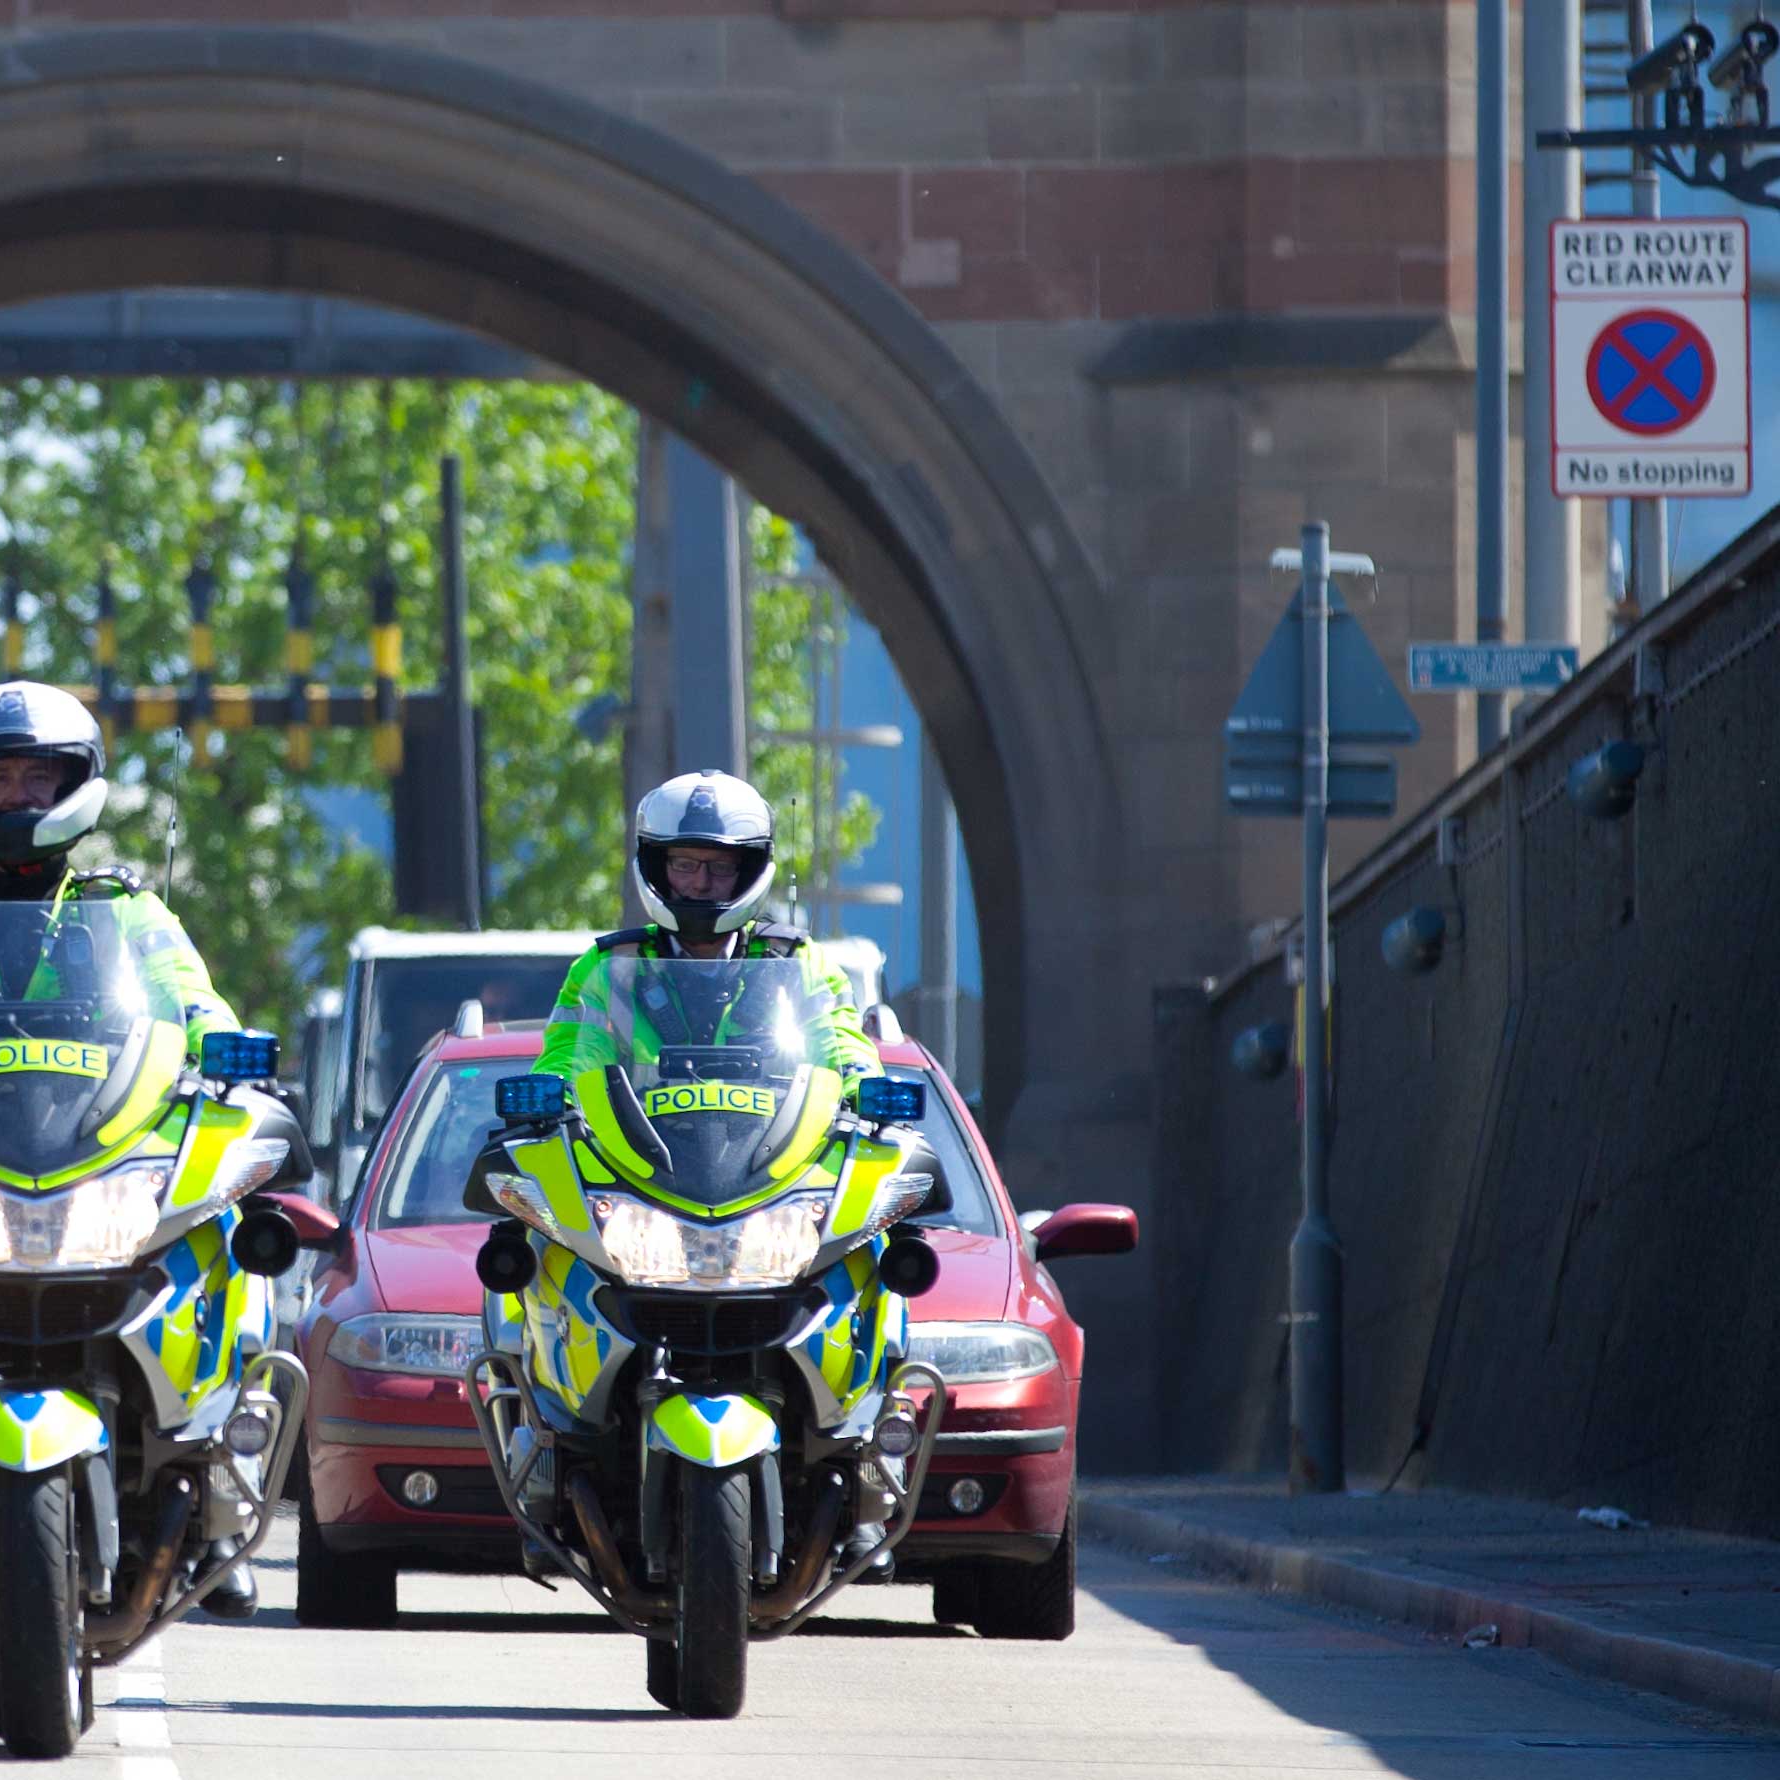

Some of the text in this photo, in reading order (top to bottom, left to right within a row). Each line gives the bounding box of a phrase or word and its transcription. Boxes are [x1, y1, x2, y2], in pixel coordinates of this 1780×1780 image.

[1564, 230, 1735, 256] RED ROUTE
[1566, 260, 1732, 286] CLEARWAY
[1569, 459, 1735, 486] No stopping
[652, 1088, 770, 1113] POLICE
